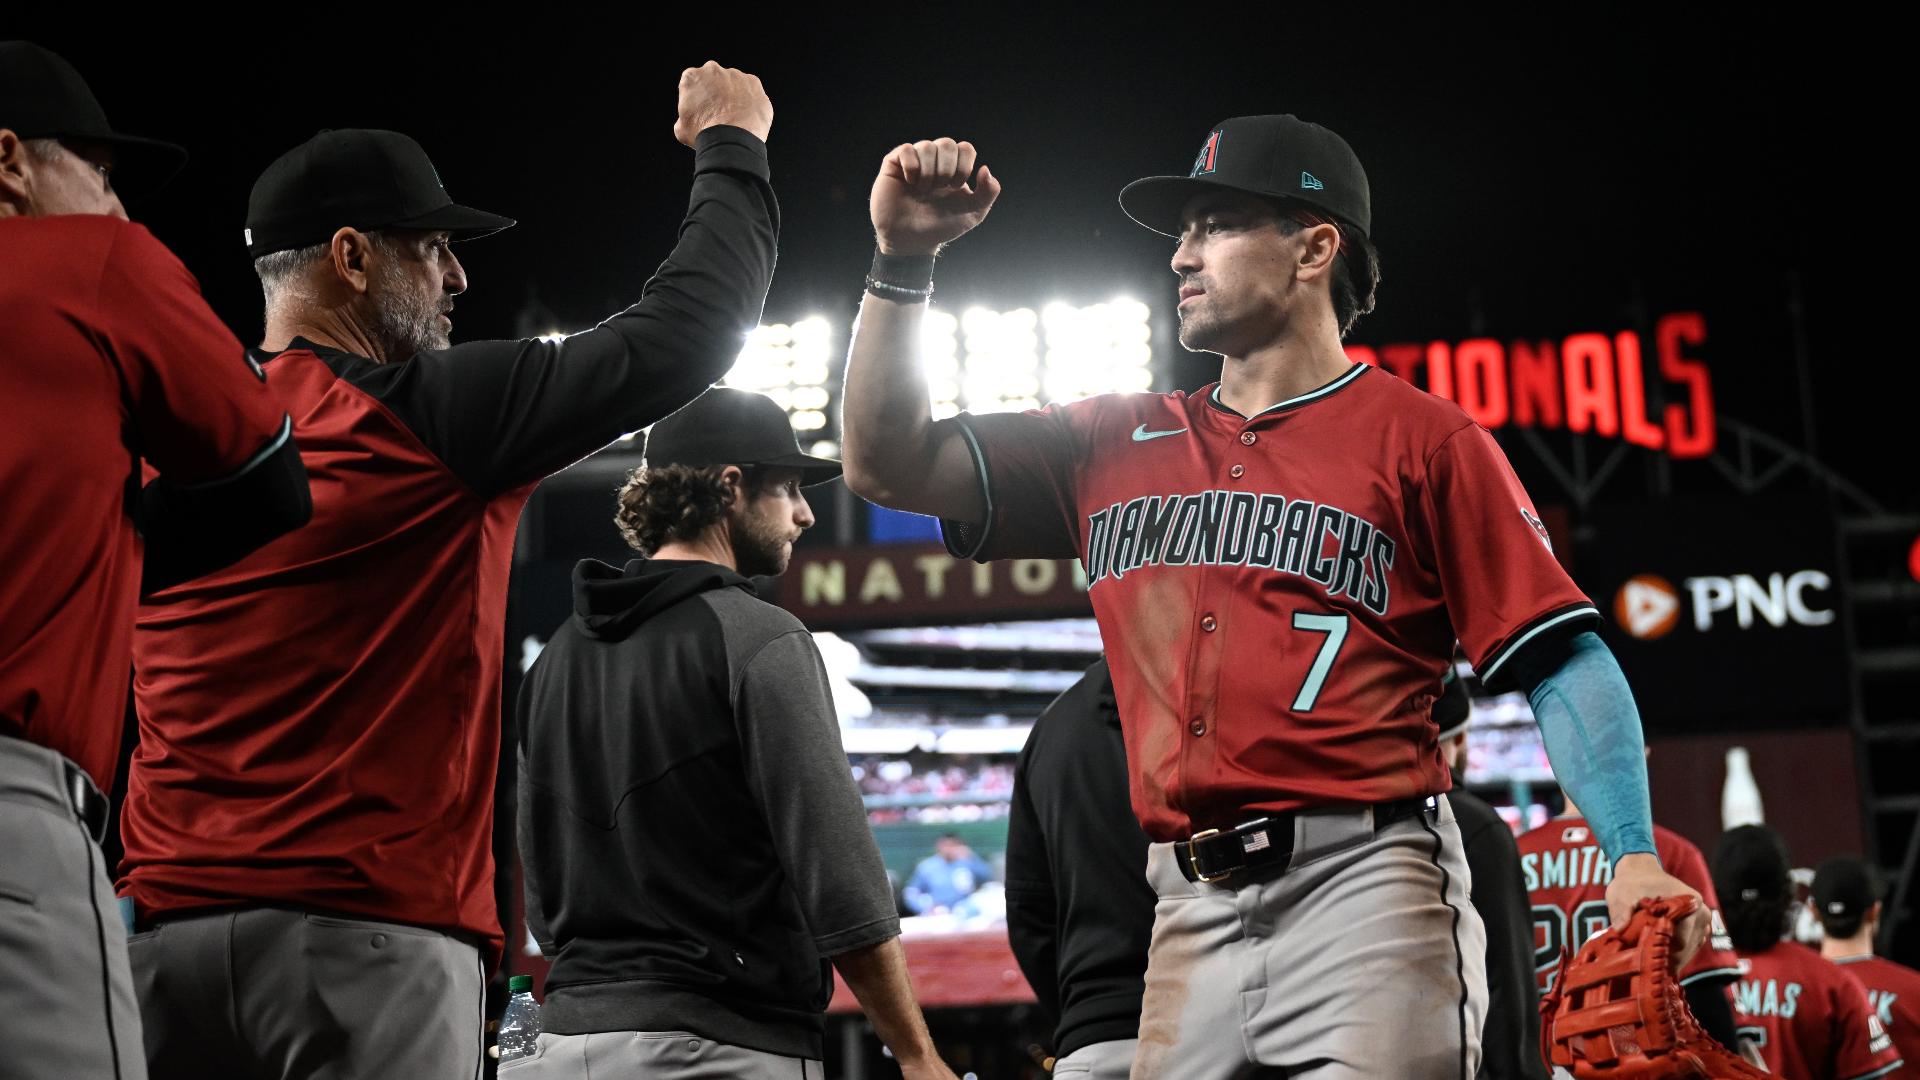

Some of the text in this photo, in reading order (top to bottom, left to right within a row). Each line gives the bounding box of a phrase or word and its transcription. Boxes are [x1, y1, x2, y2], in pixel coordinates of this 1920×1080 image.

[1087, 489, 1396, 616] DIAMONDBACKS
[1684, 569, 1835, 632] PNC
[1290, 608, 1349, 712] 7
[1736, 978, 1803, 1019] MAS
